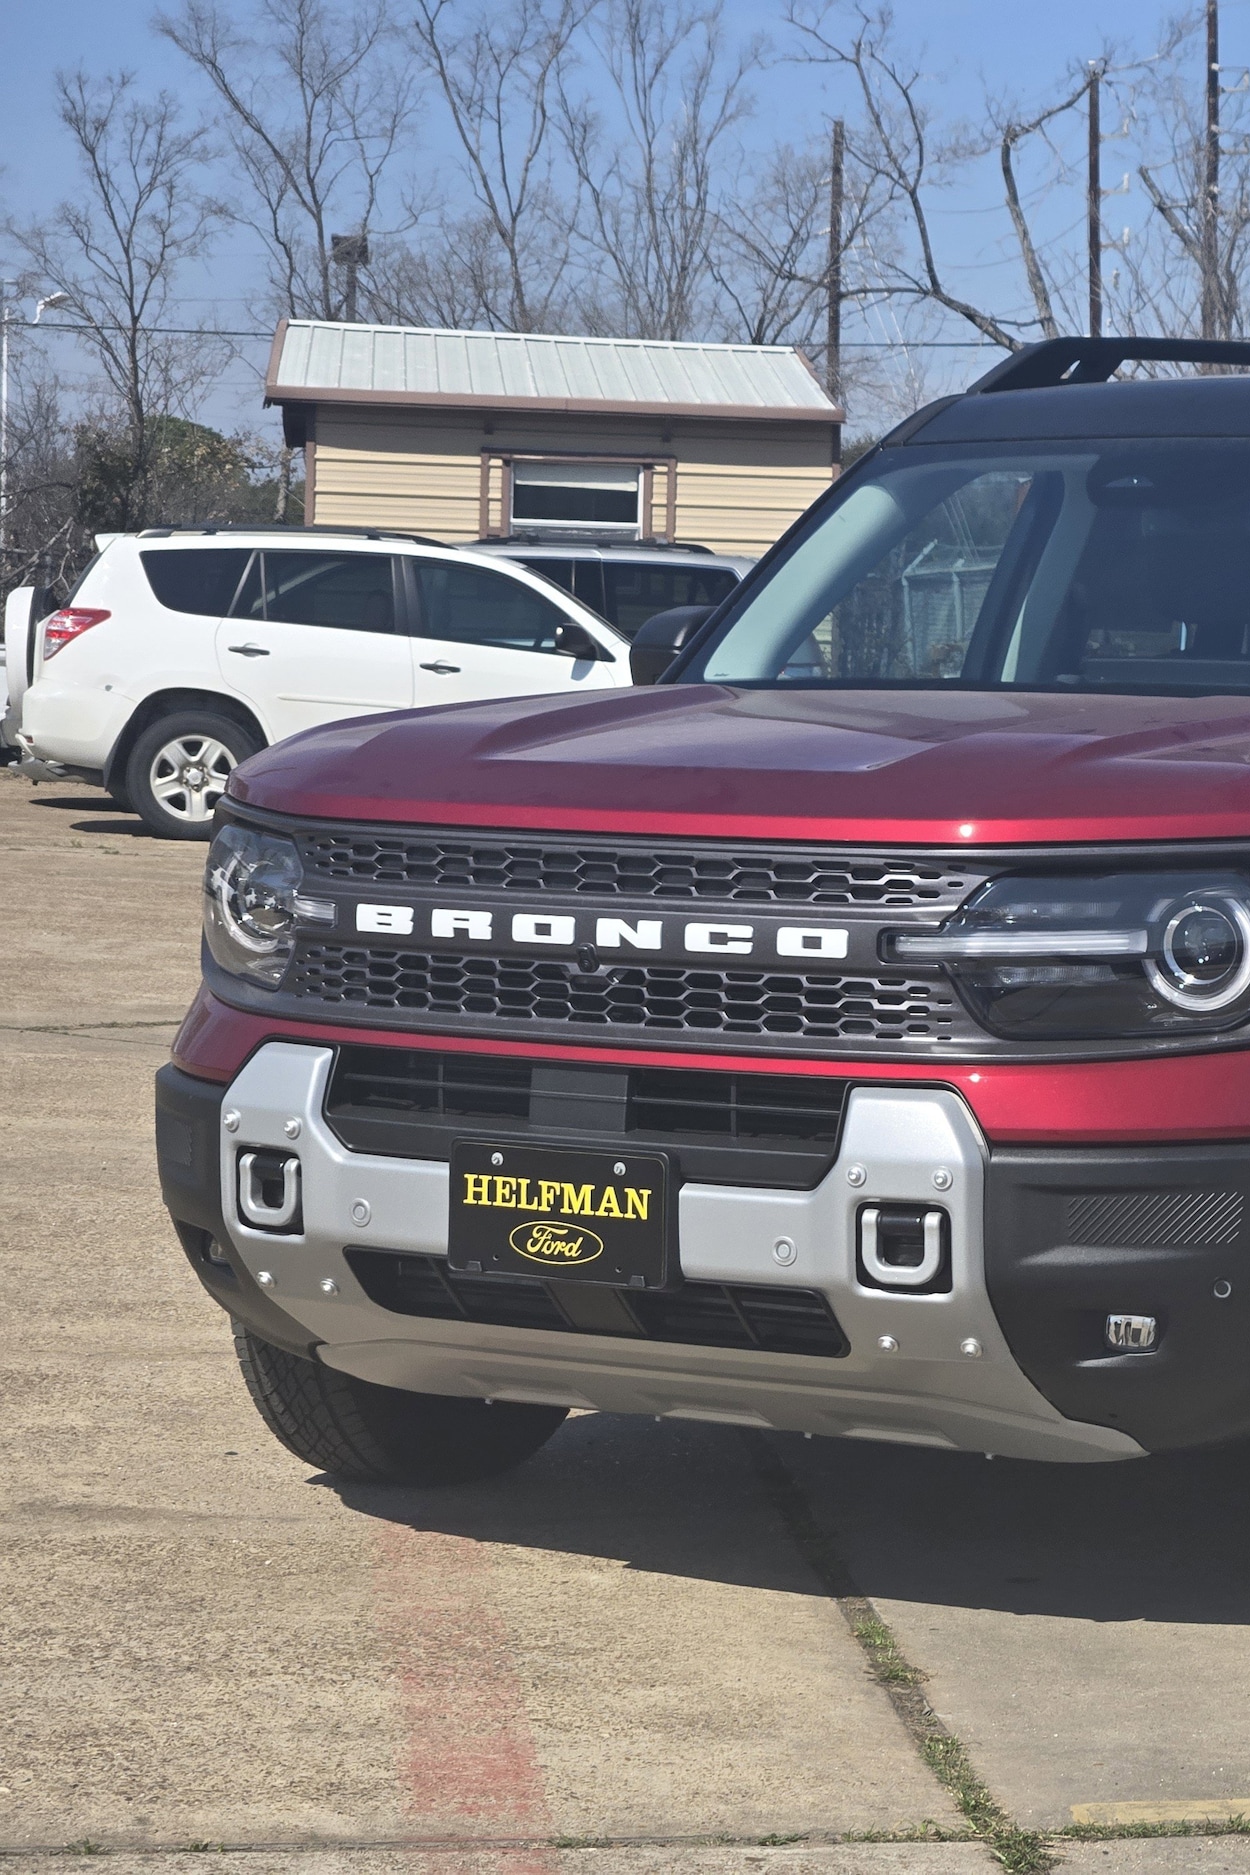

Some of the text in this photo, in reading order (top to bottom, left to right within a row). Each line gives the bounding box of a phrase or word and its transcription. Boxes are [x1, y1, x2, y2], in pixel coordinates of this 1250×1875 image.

[355, 903, 849, 959] BRONCO
[463, 1173, 652, 1220] HELFMAN
[526, 1225, 584, 1258] Ford
